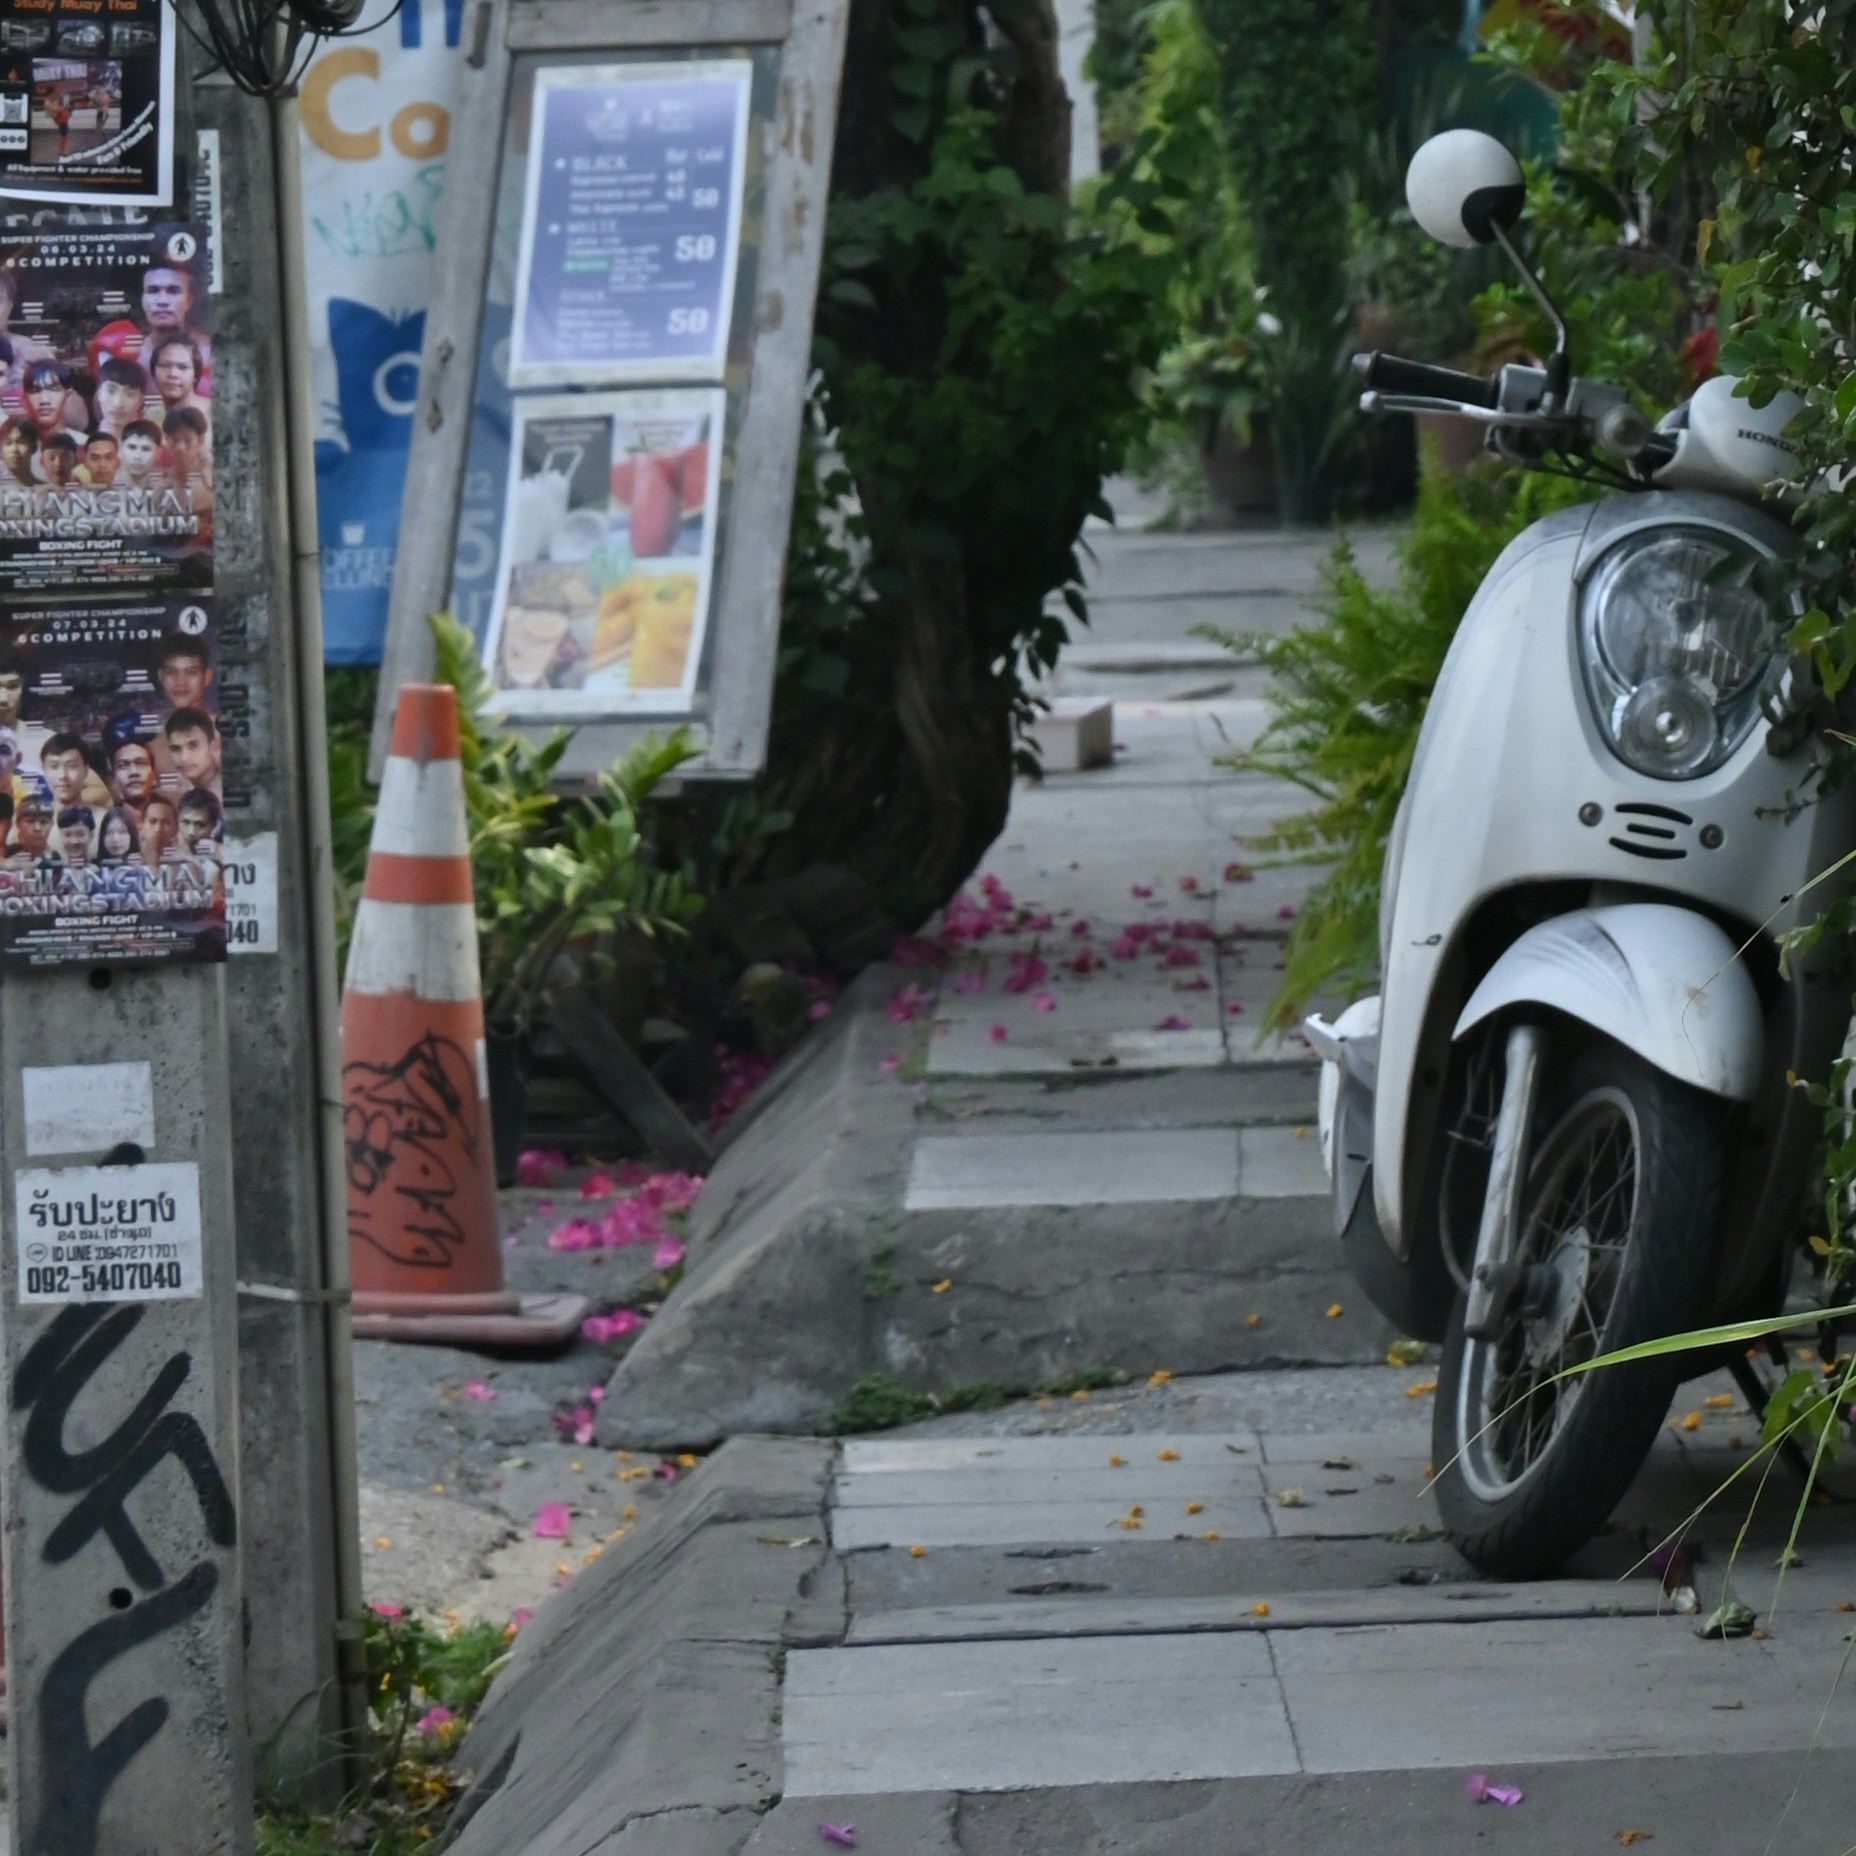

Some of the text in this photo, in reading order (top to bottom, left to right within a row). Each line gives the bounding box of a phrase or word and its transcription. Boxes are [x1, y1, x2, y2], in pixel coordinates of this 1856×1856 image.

[1, 232, 156, 244] SUPER FIGHTER CHAMPIONSHIP
[675, 234, 716, 263] 50
[666, 306, 709, 335] 50
[0, 488, 194, 518] HIANGMAI
[39, 539, 123, 551] BOXING FIGHT
[12, 611, 44, 621] SUPER
[47, 609, 89, 619] FIGHTER
[0, 890, 213, 916] OXINGSTADIUM
[55, 915, 139, 928] BOXING FIGHT
[52, 1245, 64, 1262] ID
[66, 1244, 92, 1261] LINE
[27, 1261, 182, 1294] 092-5407040
